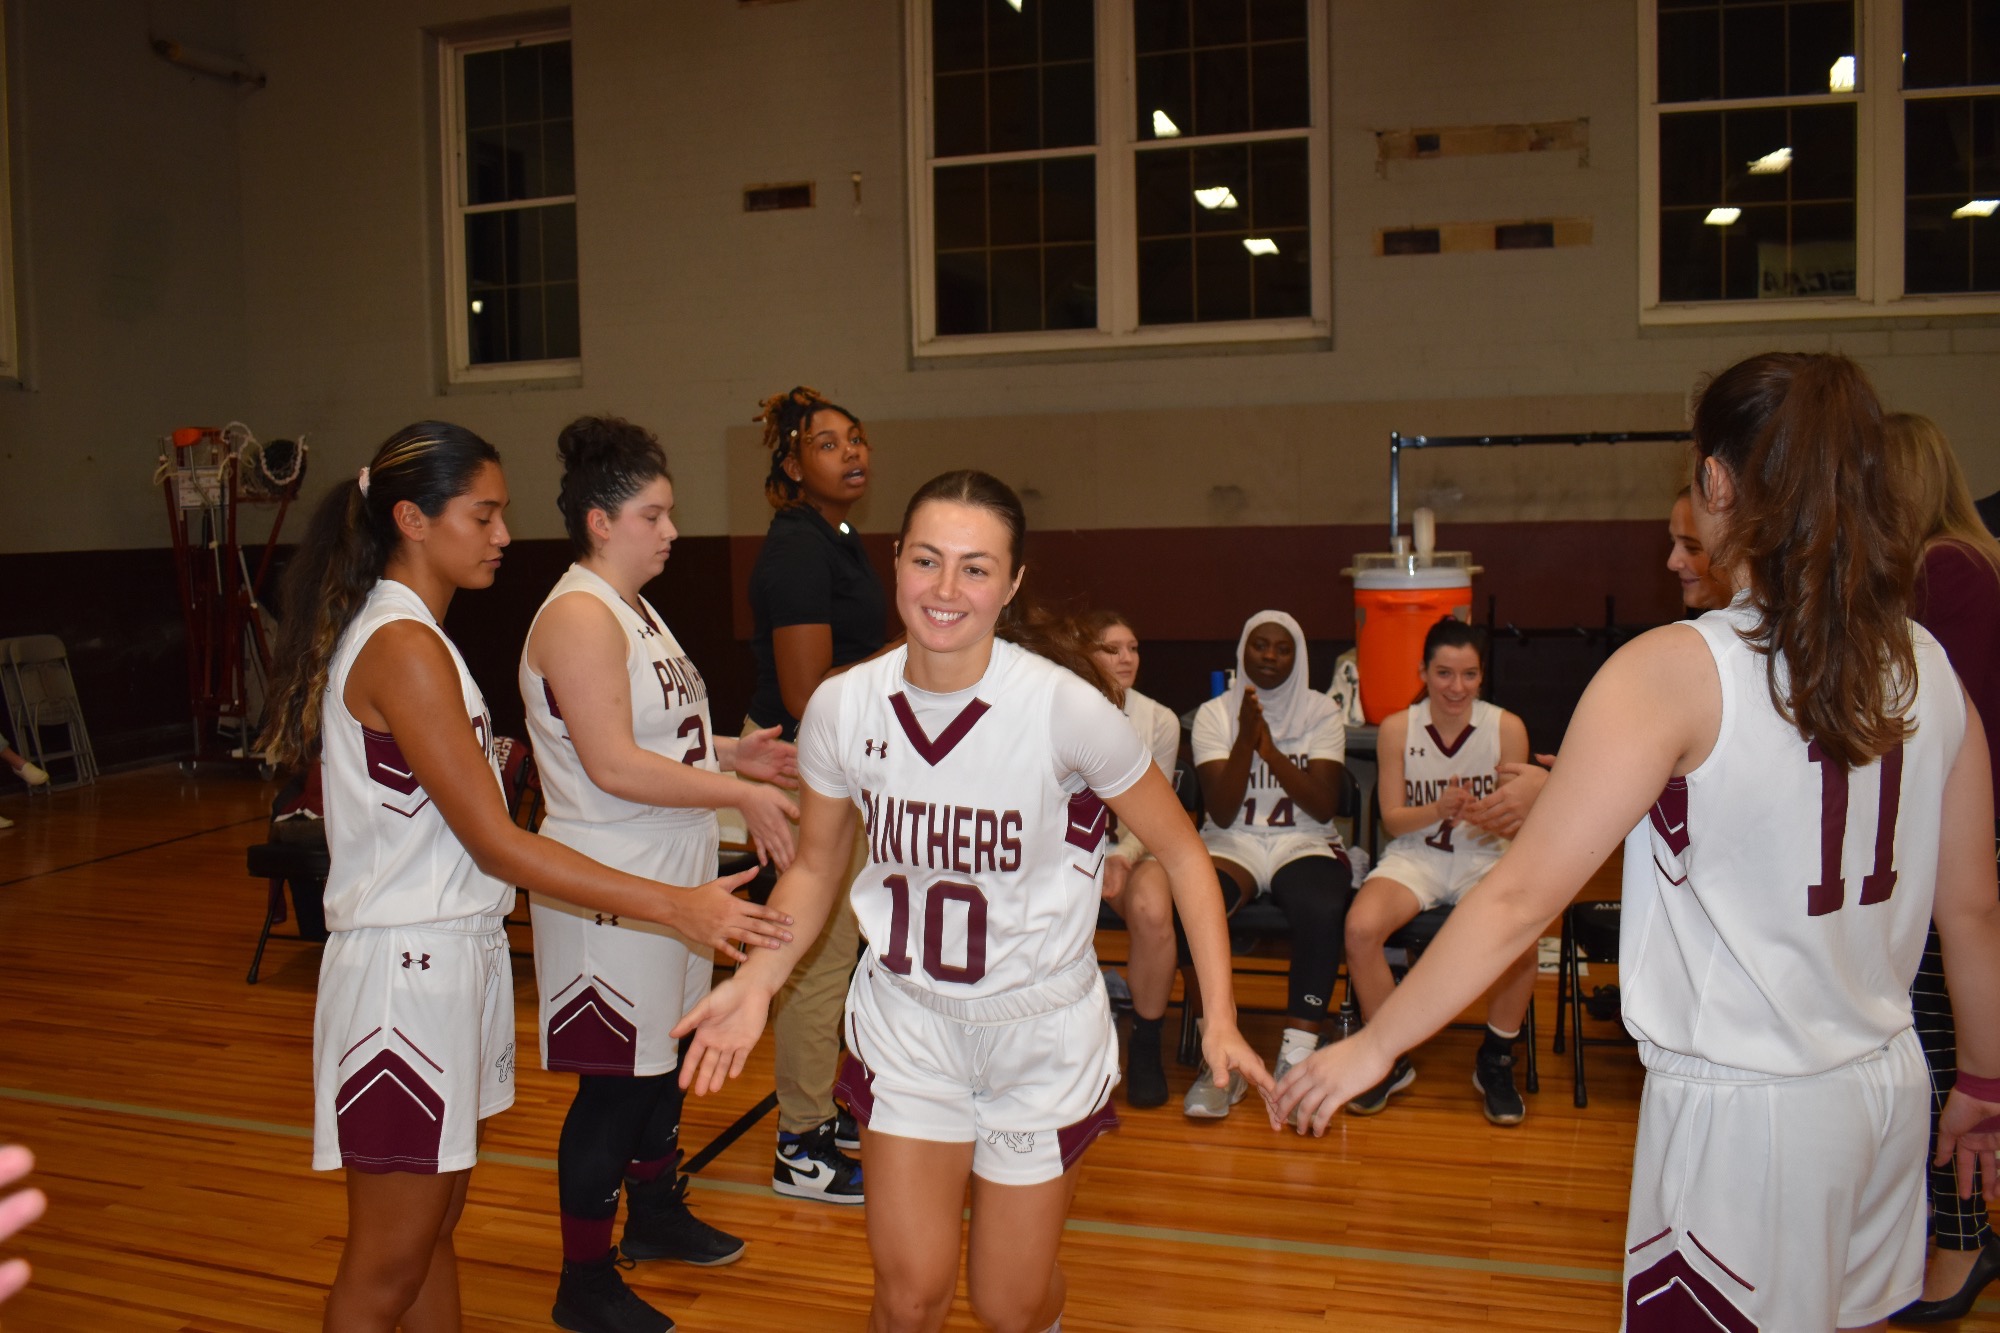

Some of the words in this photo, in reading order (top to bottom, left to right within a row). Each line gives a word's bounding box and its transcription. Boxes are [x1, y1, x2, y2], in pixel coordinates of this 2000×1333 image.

[861, 789, 1023, 874] PANTHERS
[1244, 797, 1296, 827] 14
[1405, 775, 1494, 807] PANTRS
[1808, 718, 1904, 917] 11
[879, 873, 989, 984] 10
